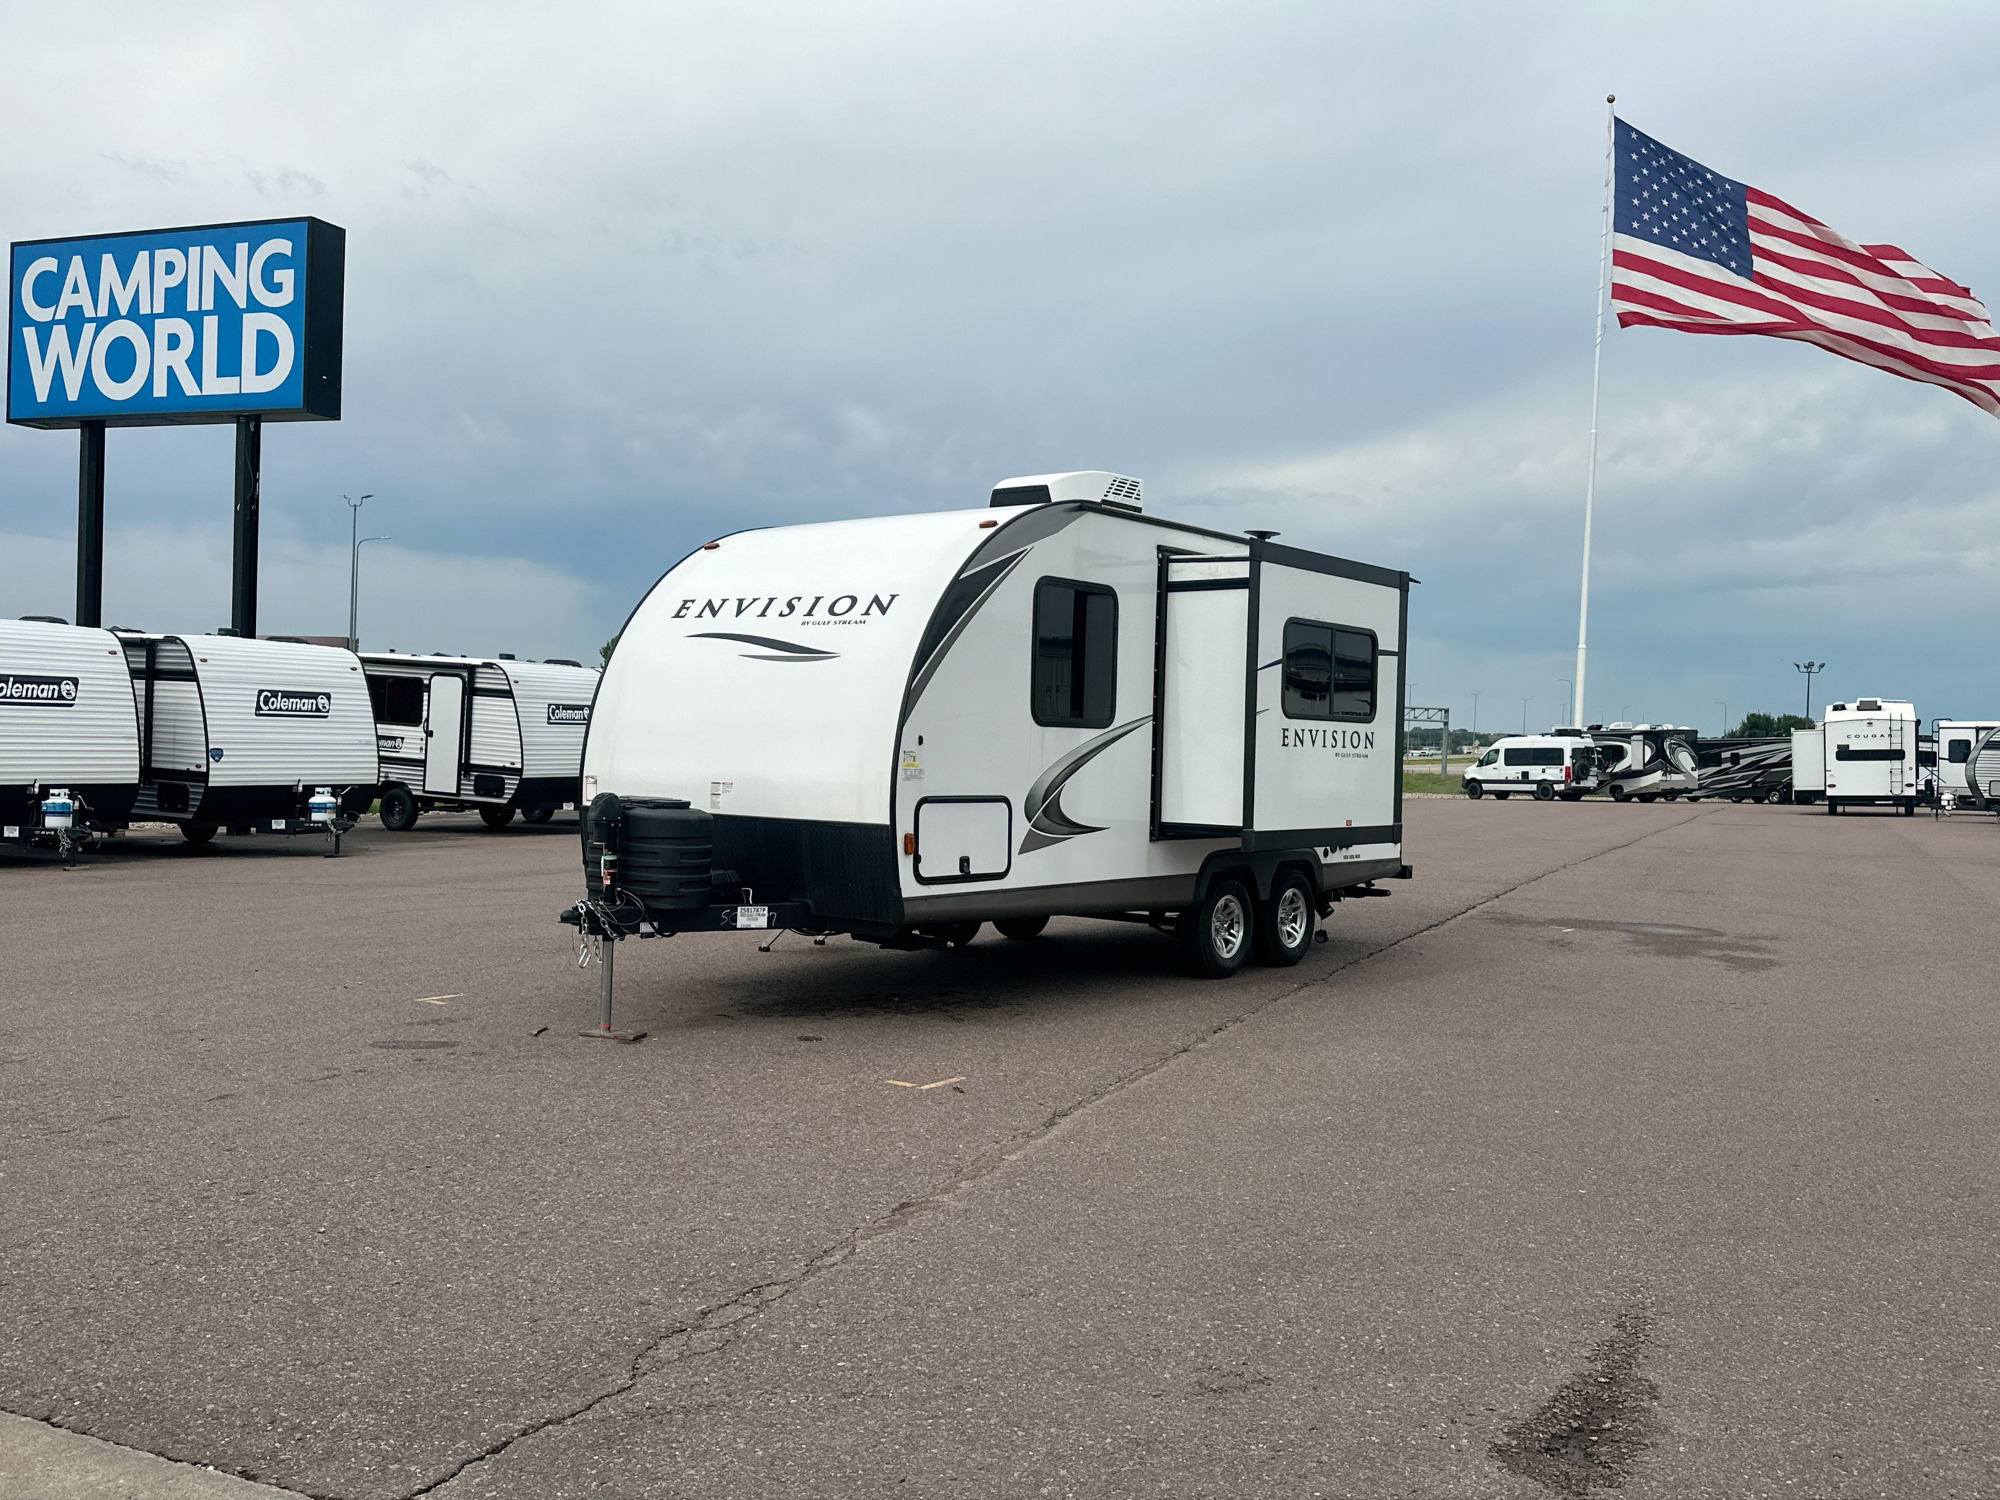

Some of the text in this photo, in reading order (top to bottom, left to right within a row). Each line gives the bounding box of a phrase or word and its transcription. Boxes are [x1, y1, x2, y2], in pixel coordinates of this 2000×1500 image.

[21, 238, 294, 322] CAMPING
[22, 312, 295, 403] WORLD
[671, 594, 899, 618] ENVISION
[0, 677, 59, 698] oleman
[260, 691, 316, 711] Coleman
[549, 705, 583, 720] Coleman
[1281, 728, 1375, 749] ENVISION
